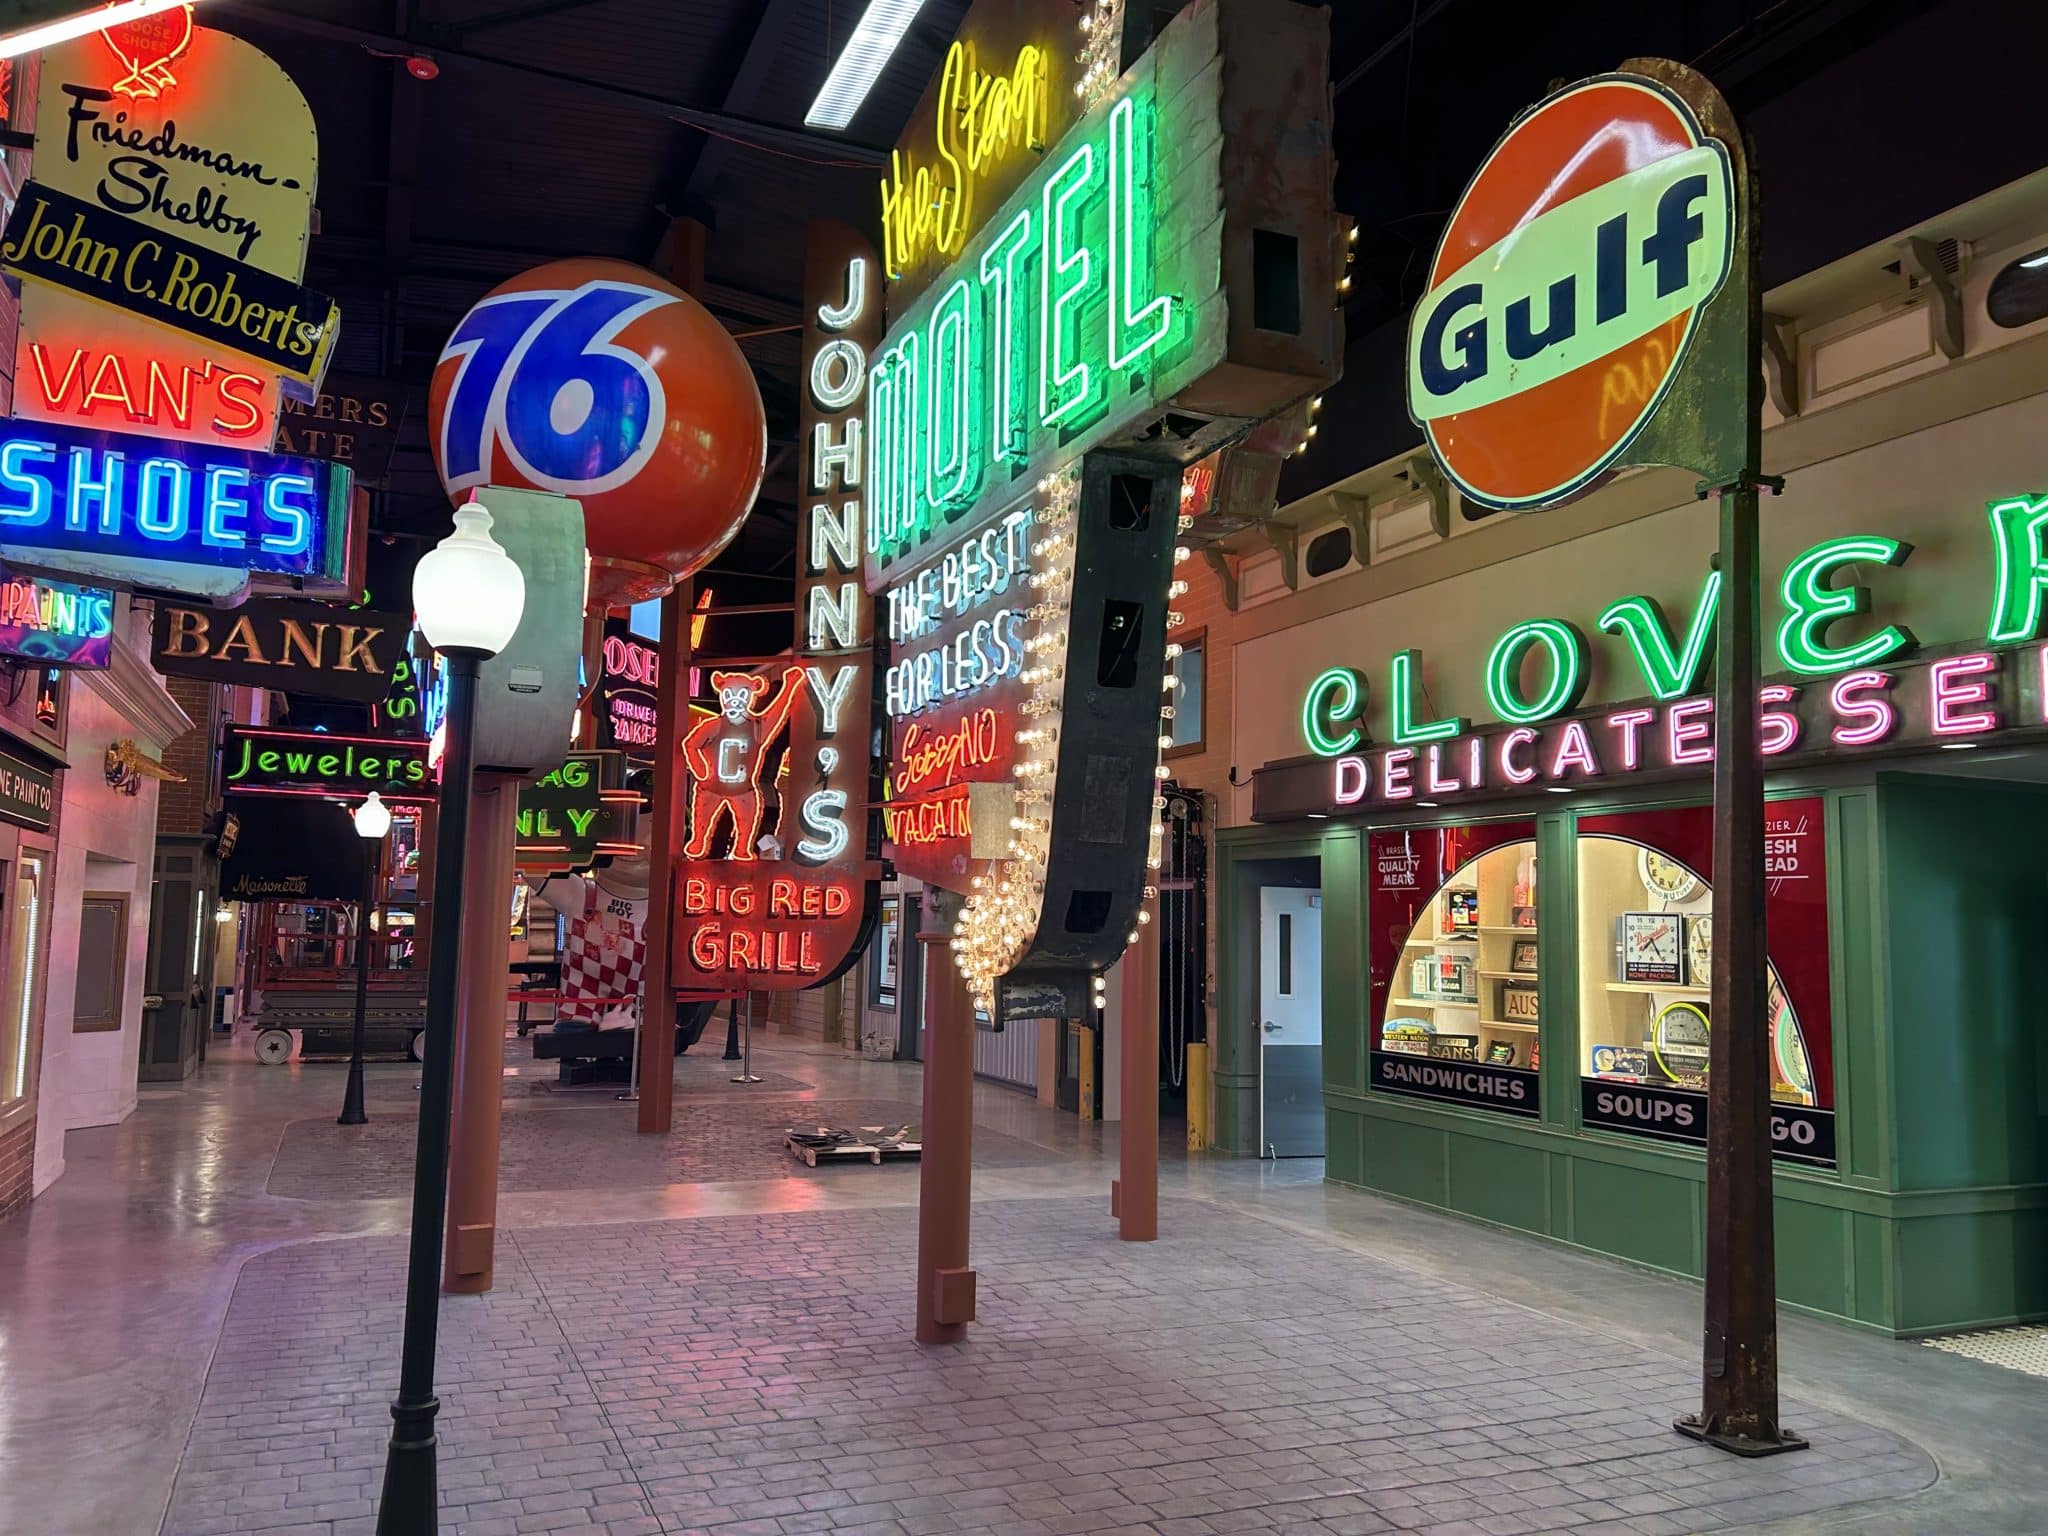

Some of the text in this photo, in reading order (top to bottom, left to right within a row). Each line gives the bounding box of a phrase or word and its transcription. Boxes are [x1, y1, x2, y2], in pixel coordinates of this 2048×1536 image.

[61, 83, 300, 189] Friedman-
[97, 155, 261, 260] Shelby
[3, 198, 313, 356] John C. Roberts
[1419, 174, 1708, 397] Gulf
[869, 97, 1178, 554] MOTEL
[29, 343, 264, 438] VAN'S
[437, 280, 684, 496] 76
[0, 438, 314, 555] SHOES
[886, 510, 1028, 641] THE BEST
[161, 607, 385, 675] BANK
[886, 609, 1018, 717] FOR LESS
[961, 708, 996, 768] NO
[1334, 643, 2048, 805] DELICATESSE
[228, 738, 425, 782] Jewelers
[13, 775, 40, 807] PAINT
[40, 786, 51, 811] CO
[890, 797, 972, 846] VACAN
[1765, 820, 1791, 831] ZIER
[1378, 859, 1420, 873] QUALITY
[1764, 838, 1797, 855] ESH
[1764, 856, 1798, 872] EAD
[232, 874, 311, 896] Maisonette
[684, 877, 851, 917] BIG RED
[1382, 873, 1415, 886] MEATS
[607, 905, 634, 920] BOY
[611, 898, 633, 911] BIG
[692, 921, 821, 973] GRILL
[1382, 1061, 1525, 1100] SANDWICHES
[1597, 1092, 1694, 1126] SOUPS
[1771, 1116, 1816, 1145] GO
